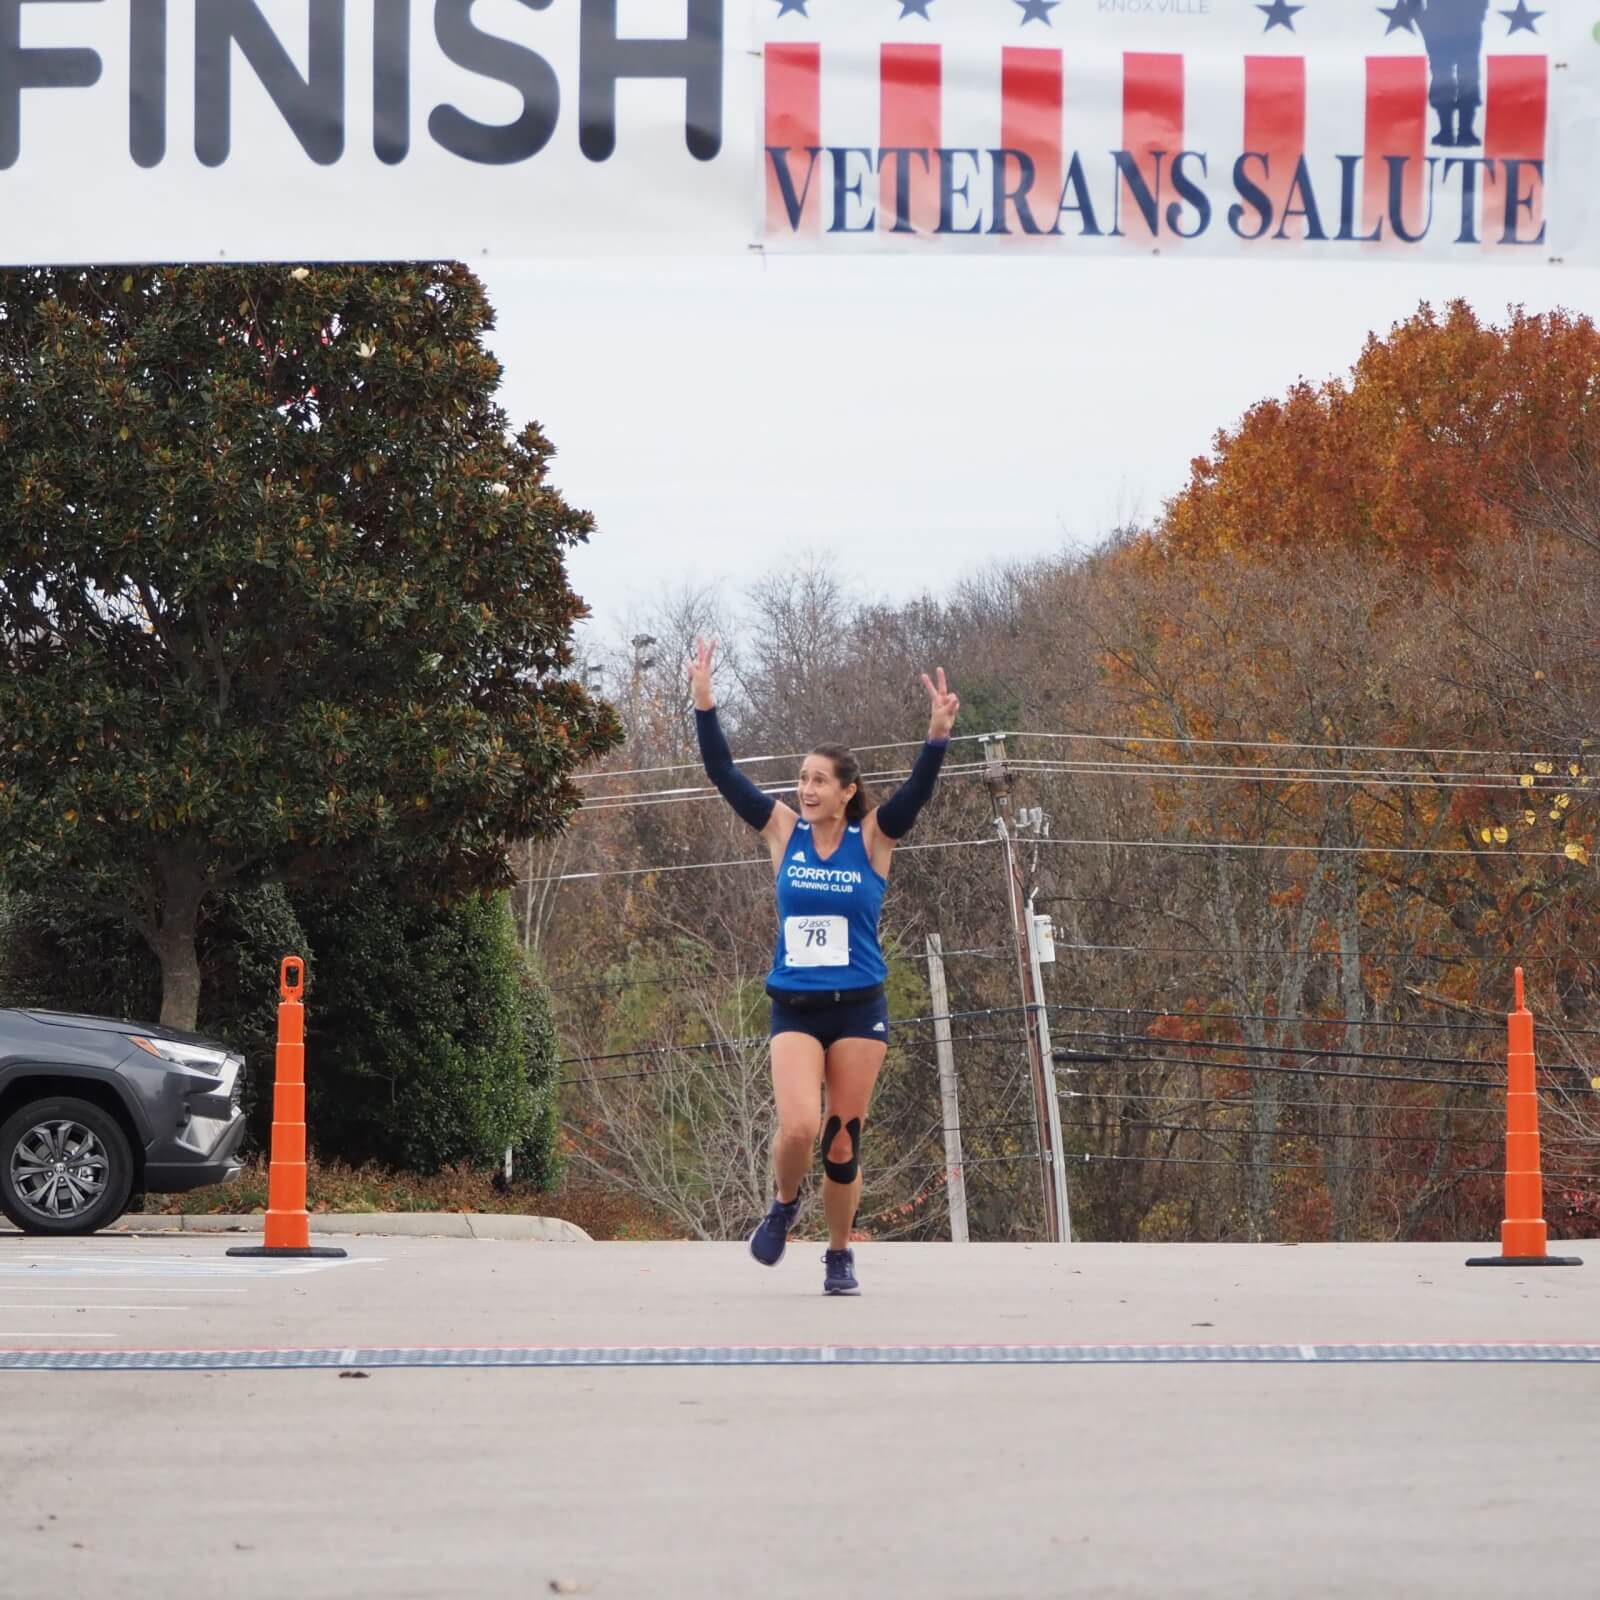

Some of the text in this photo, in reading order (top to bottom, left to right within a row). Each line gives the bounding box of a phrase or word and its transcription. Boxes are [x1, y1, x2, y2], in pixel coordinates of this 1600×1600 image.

[0, 0, 723, 170] FINISH
[764, 146, 1547, 246] VETERANS SALUTE
[787, 865, 861, 883] CORRYTON
[791, 879, 853, 893] RUNNING CLUB
[804, 928, 827, 948] 78
